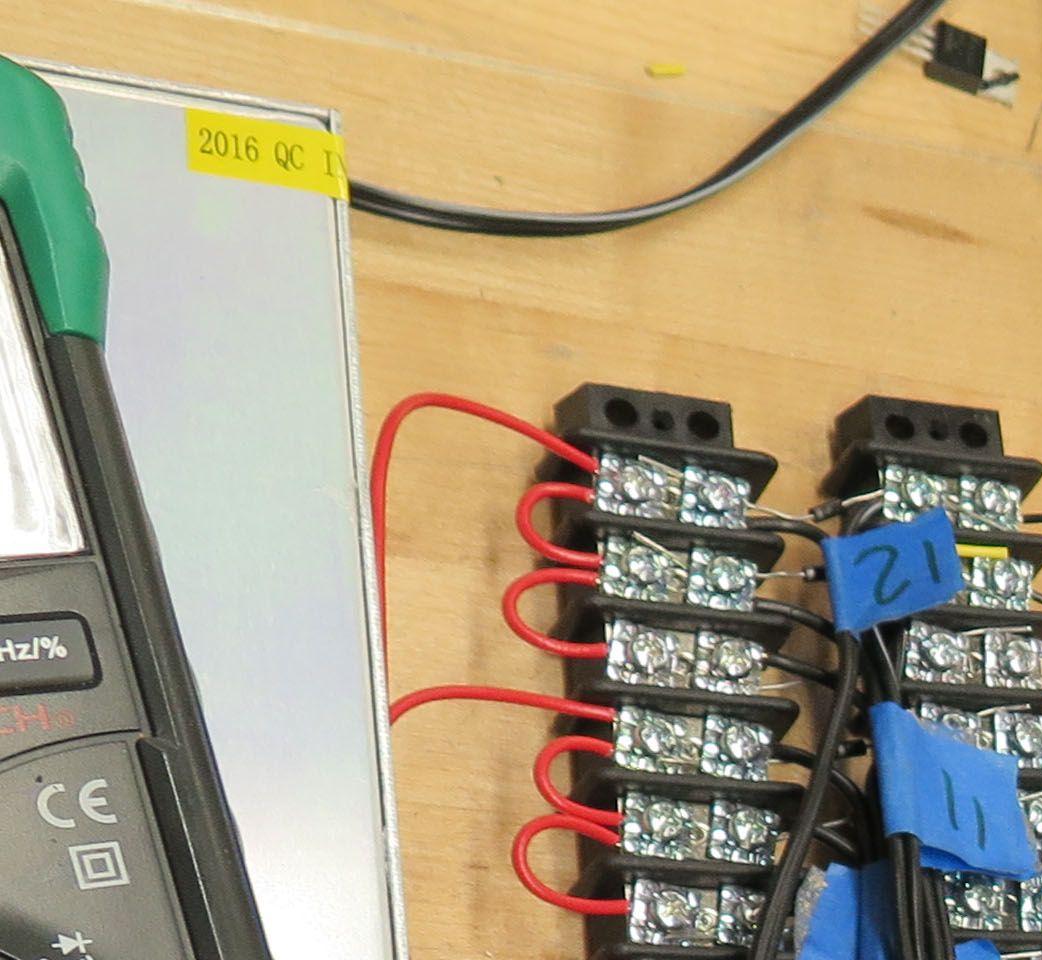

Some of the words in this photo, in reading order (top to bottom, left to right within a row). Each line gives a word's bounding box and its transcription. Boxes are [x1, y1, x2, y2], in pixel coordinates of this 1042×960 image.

[198, 127, 259, 163] 2016
[274, 140, 305, 172] QC
[37, 779, 118, 829] CE
